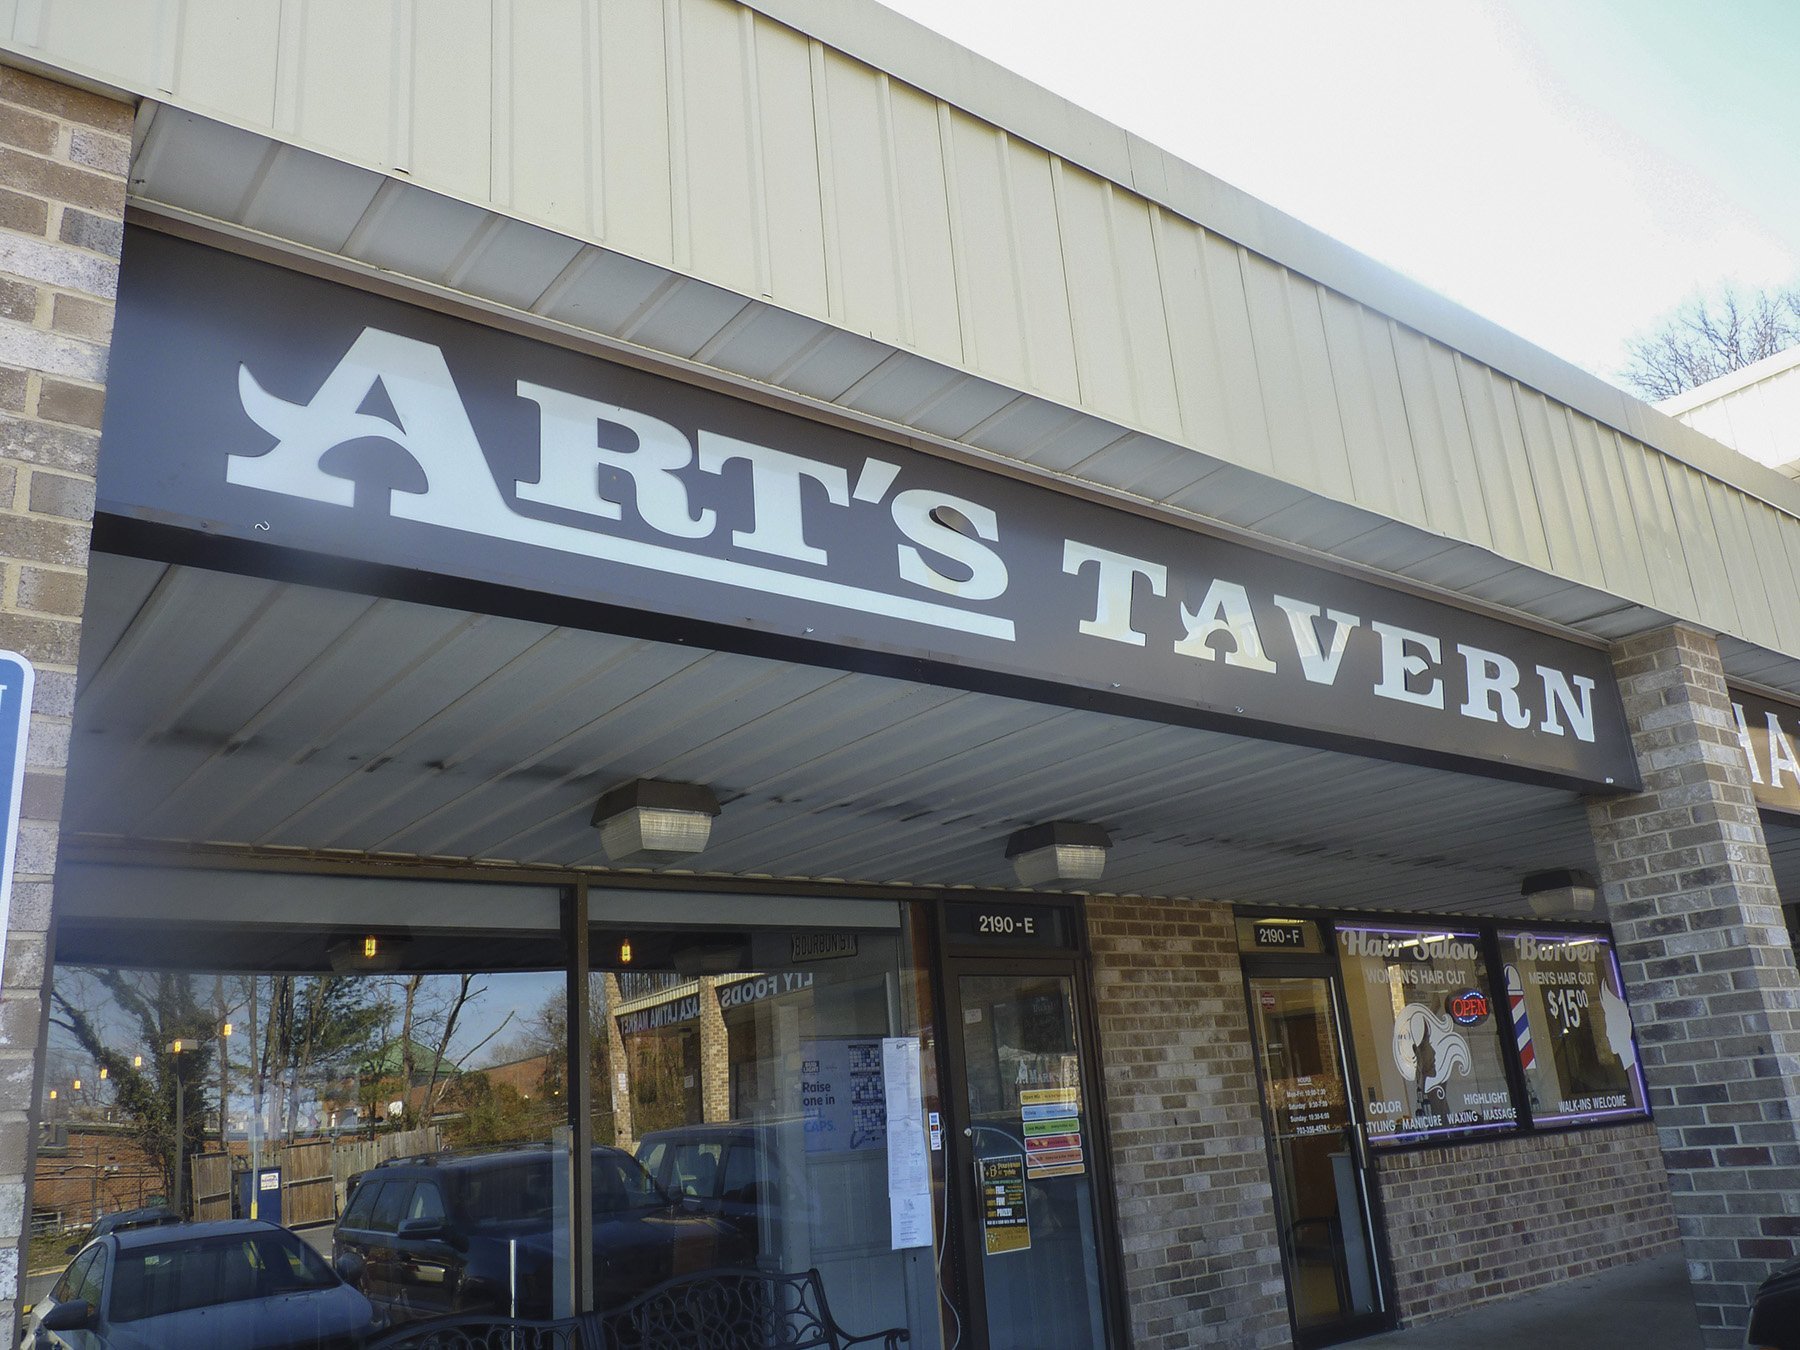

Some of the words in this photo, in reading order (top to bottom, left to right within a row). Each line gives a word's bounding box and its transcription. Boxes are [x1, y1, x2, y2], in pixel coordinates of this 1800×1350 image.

[226, 326, 1016, 642] ART'S
[1062, 539, 1596, 742] TAVERN
[1732, 703, 1800, 789] HA
[1341, 929, 1401, 957] Hair
[1413, 932, 1478, 960] Salon
[1514, 932, 1600, 962] Barber
[1420, 970, 1444, 985] HAIR
[1446, 971, 1466, 985] CUT
[1528, 972, 1556, 985] MEN'S
[1557, 972, 1577, 985] HAIR
[1578, 972, 1595, 985] CUT
[1453, 998, 1488, 1017] OPEN
[803, 1082, 831, 1093] Raise
[803, 1096, 824, 1106] one
[826, 1095, 835, 1105] in
[1369, 1101, 1402, 1114] COLOR
[1463, 1092, 1508, 1105] HIGHLIGHT
[1558, 1097, 1591, 1112] WALK-INS
[1592, 1095, 1627, 1109] WELCOME
[1402, 1115, 1442, 1130] MANICURE
[1447, 1110, 1478, 1125] WAXING
[1483, 1107, 1517, 1120] MASSAGE
